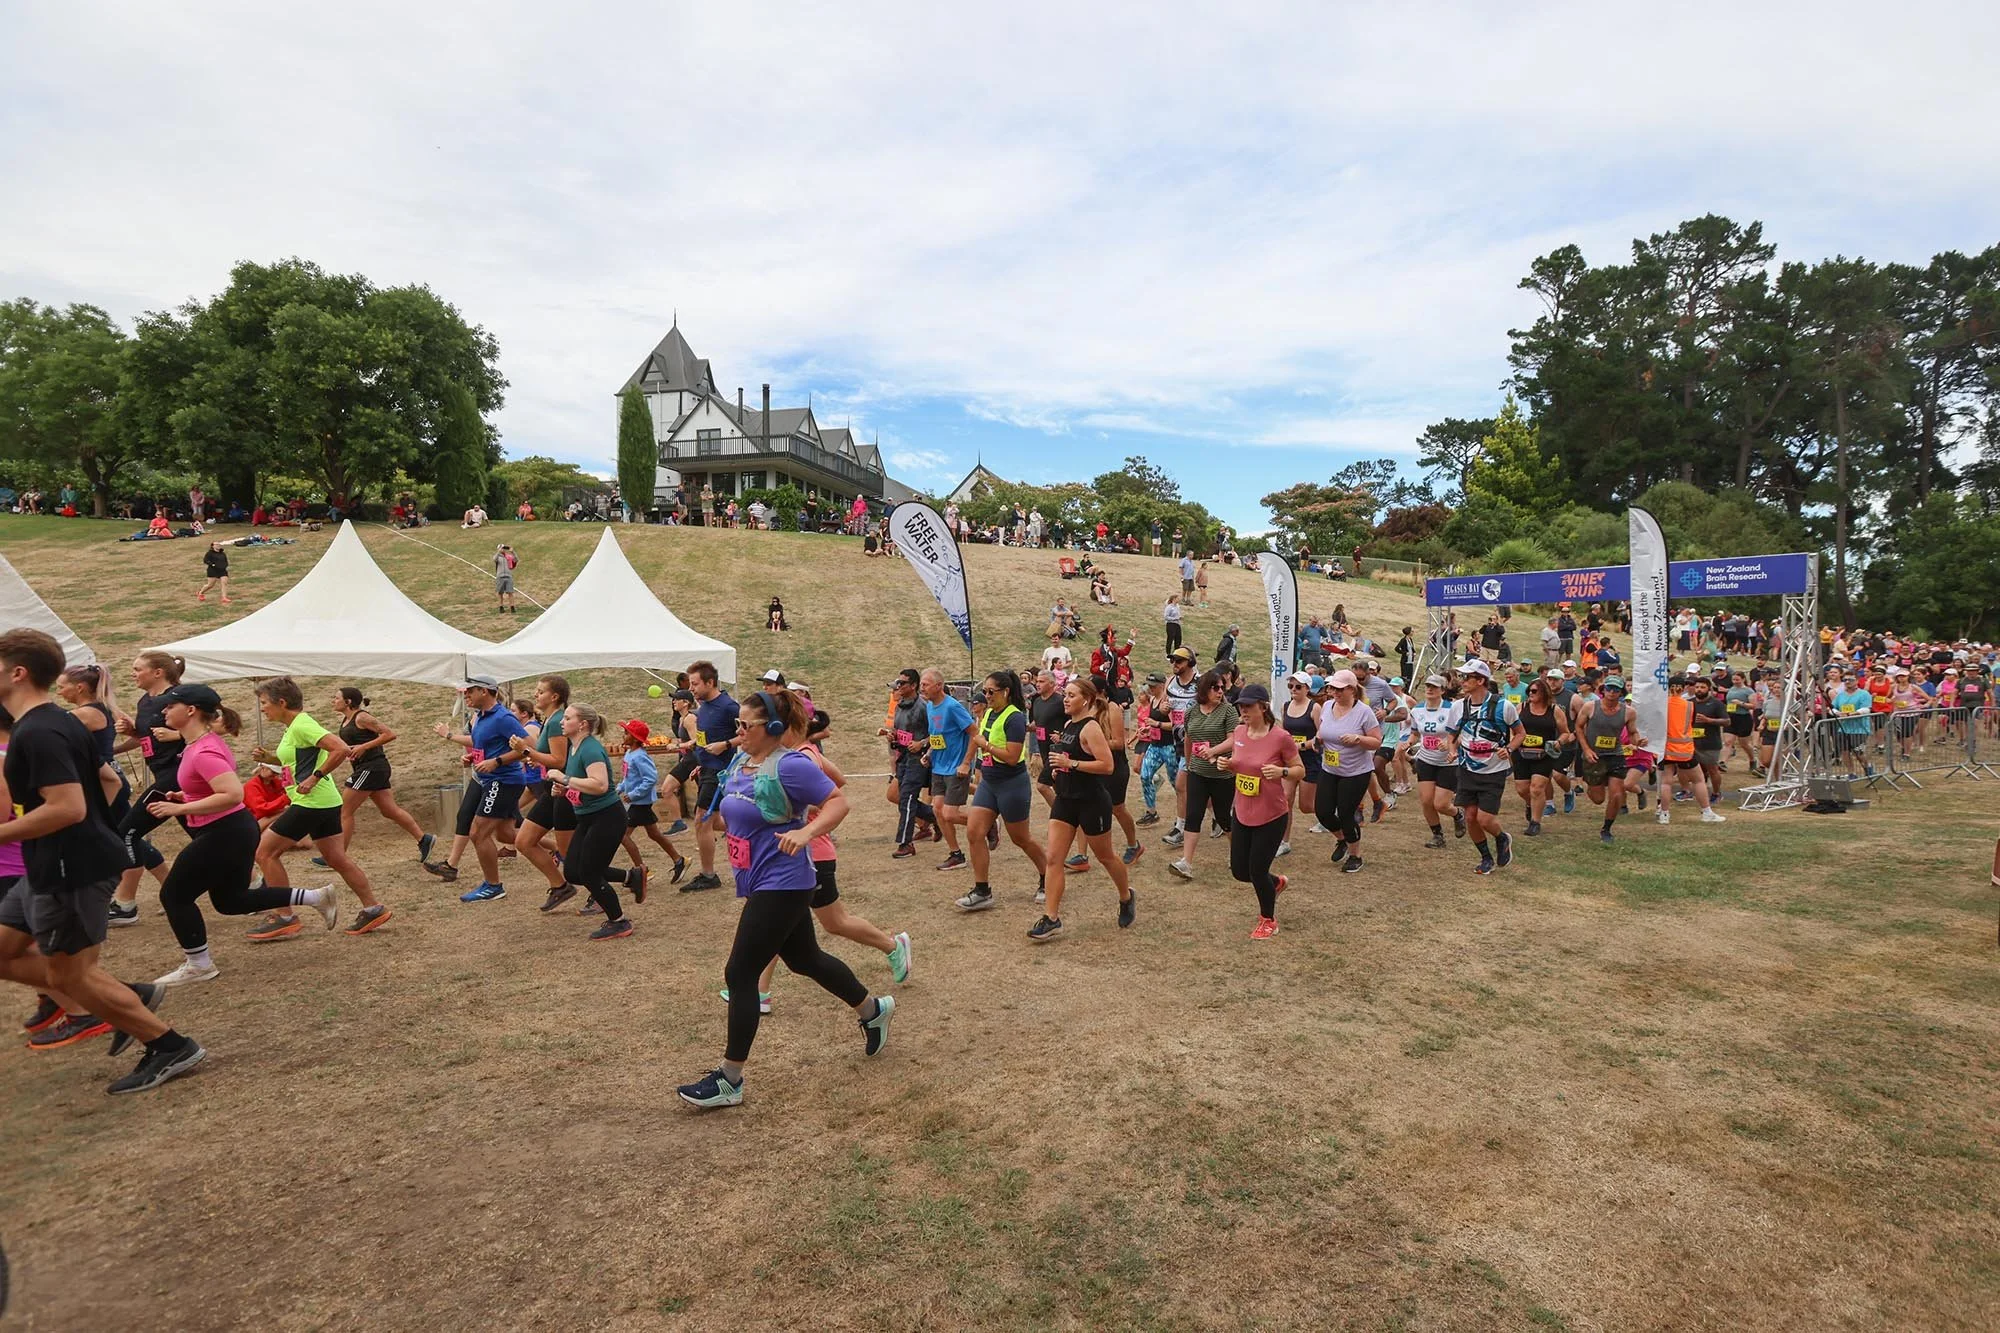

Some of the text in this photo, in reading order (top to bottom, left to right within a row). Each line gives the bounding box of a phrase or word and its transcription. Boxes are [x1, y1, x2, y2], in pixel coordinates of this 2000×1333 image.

[912, 511, 938, 543] FREE
[904, 518, 939, 564] WATER
[1706, 564, 1761, 574] New Zealand
[1564, 572, 1603, 585] VINE
[1706, 572, 1768, 582] Brain Research
[1443, 582, 1480, 594] PEGASUS BAY
[1566, 585, 1603, 598] RUN
[1706, 582, 1739, 590] Institute
[1651, 576, 1663, 651] New Zealand
[1640, 592, 1651, 651] Friends of the
[1280, 615, 1290, 651] Institute
[1424, 722, 1437, 733] 22
[1239, 780, 1254, 791] 769
[483, 781, 499, 814] adidas
